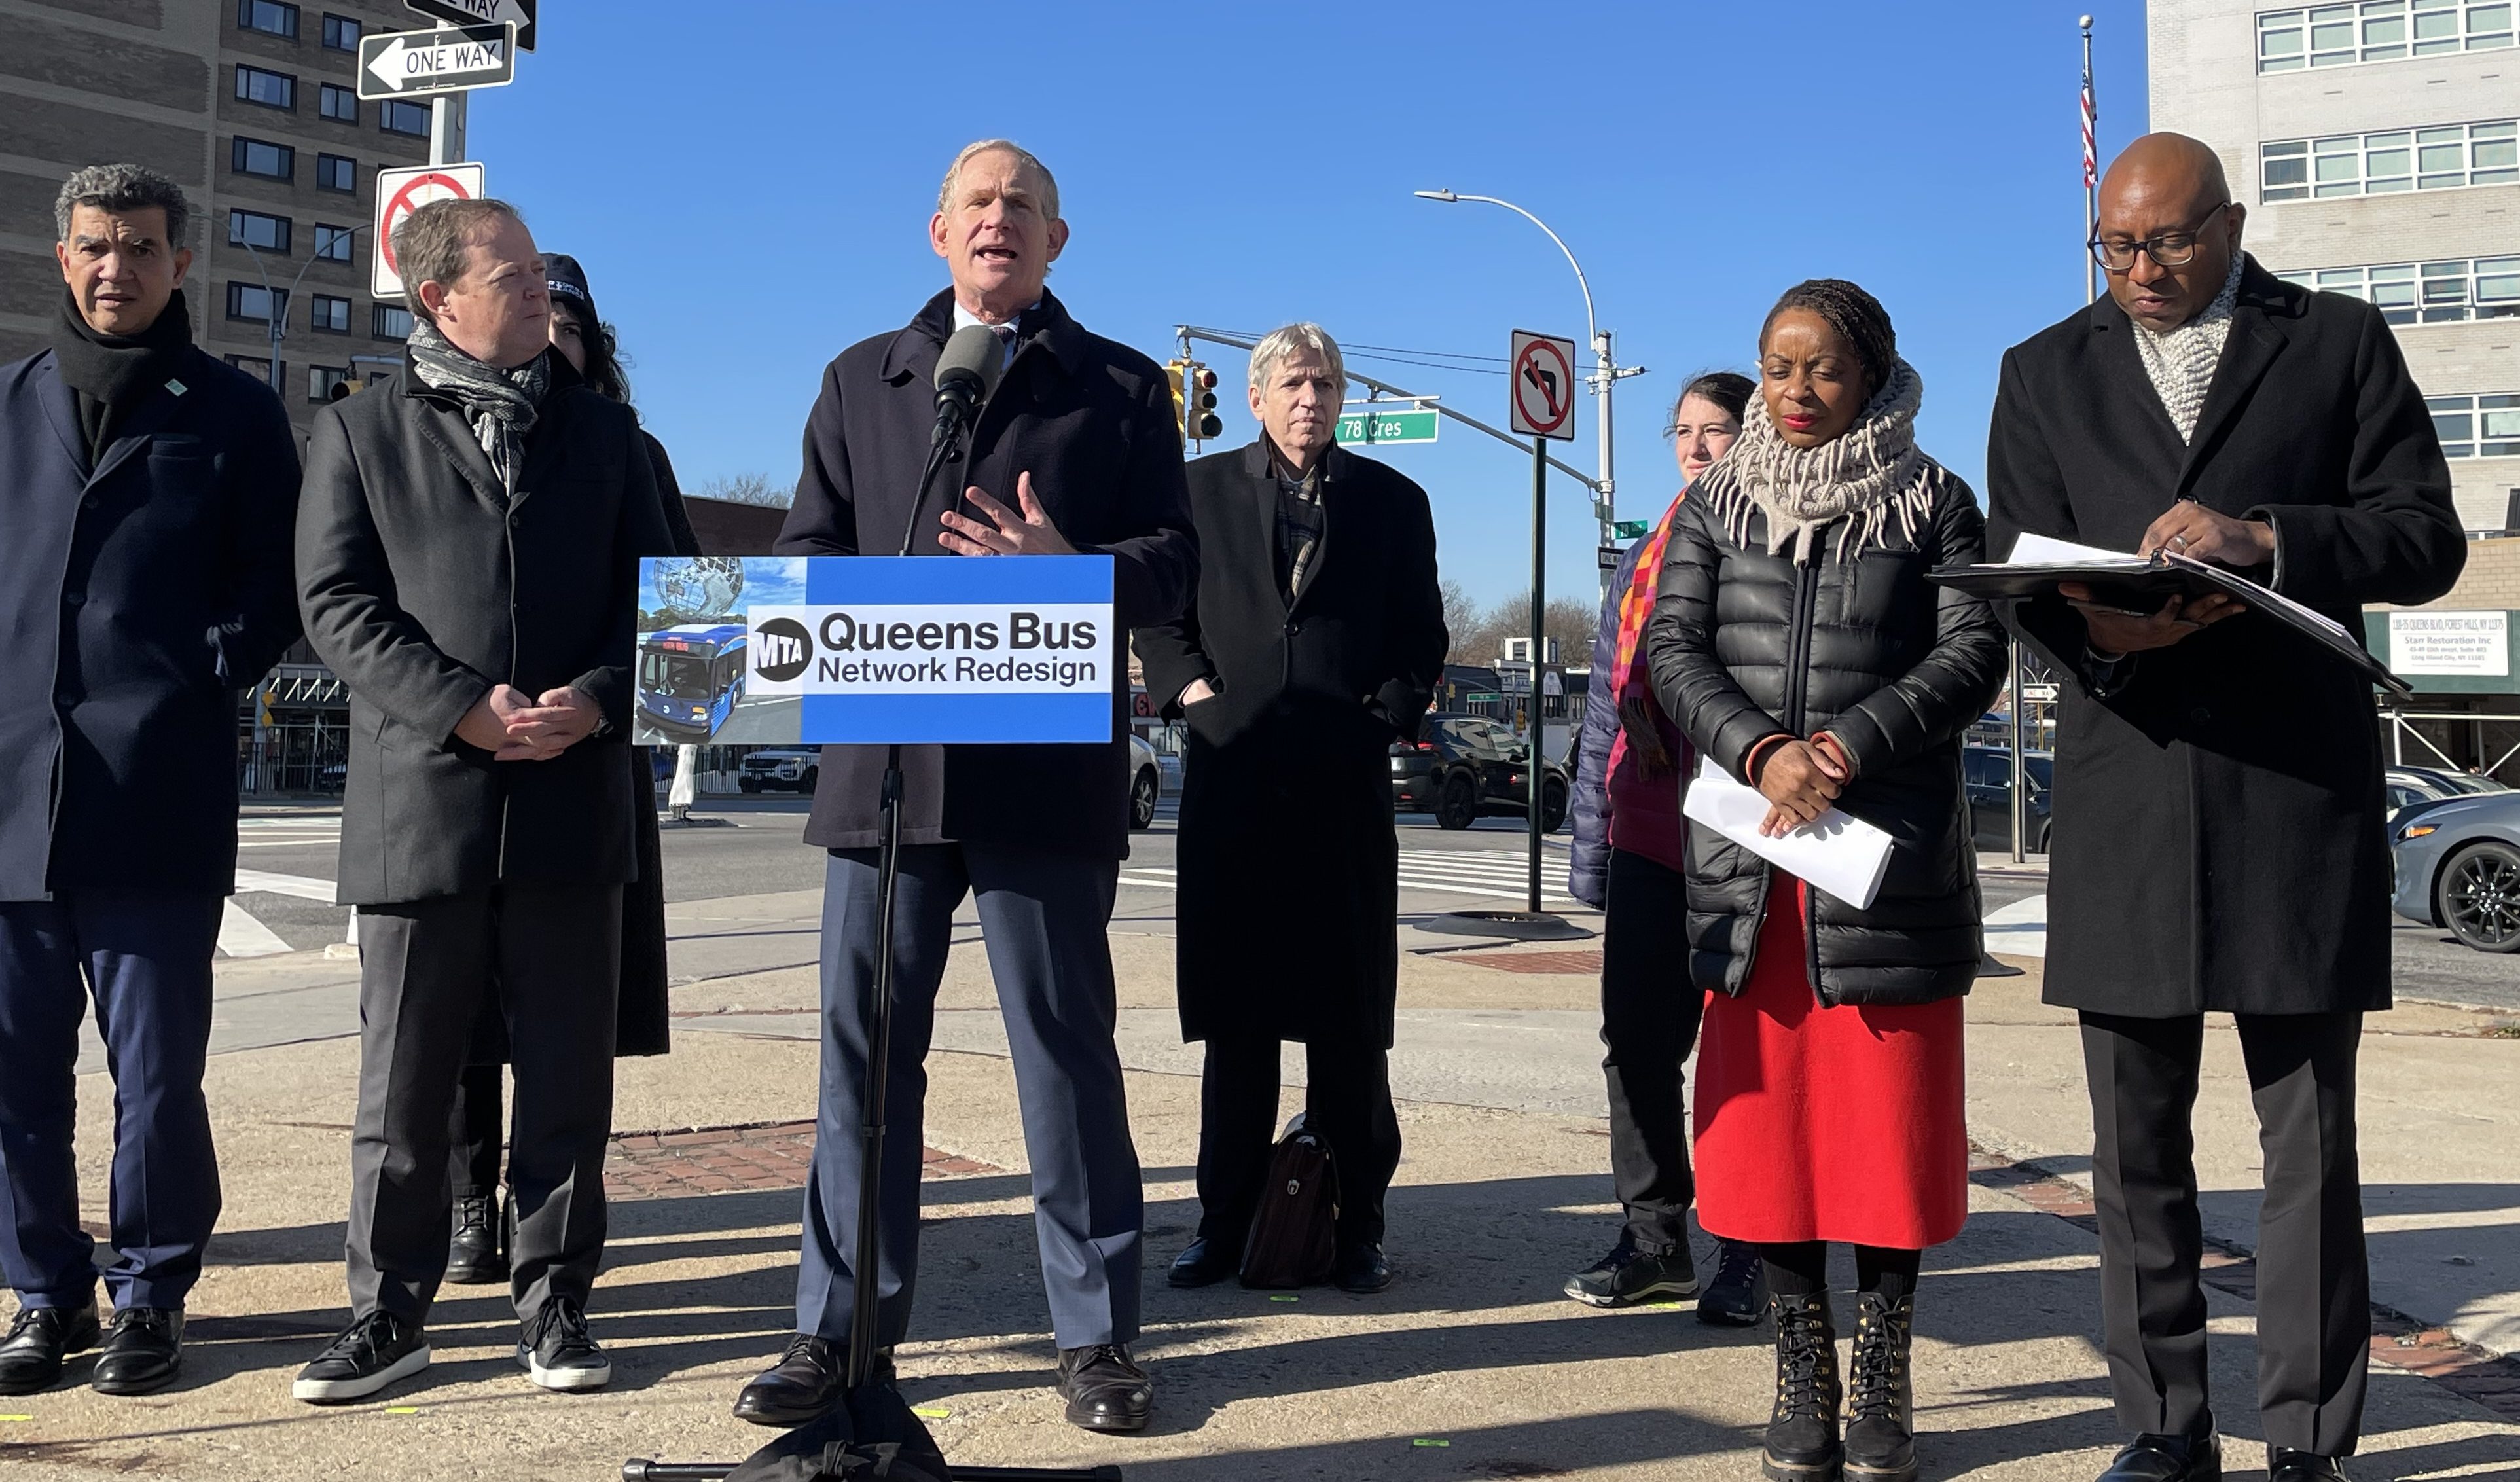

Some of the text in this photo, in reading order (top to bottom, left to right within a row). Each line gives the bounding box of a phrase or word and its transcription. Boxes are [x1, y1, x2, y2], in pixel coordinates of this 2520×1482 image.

[407, 43, 497, 74] ONE WAY
[1344, 420, 1402, 439] 78 Cres
[819, 612, 1097, 653] Queens Bus
[2409, 619, 2430, 630] QUEENS
[2445, 619, 2464, 630] FOREST
[2480, 619, 2488, 630] NY
[755, 632, 803, 669] MTA
[818, 656, 1096, 687] Network Redesign
